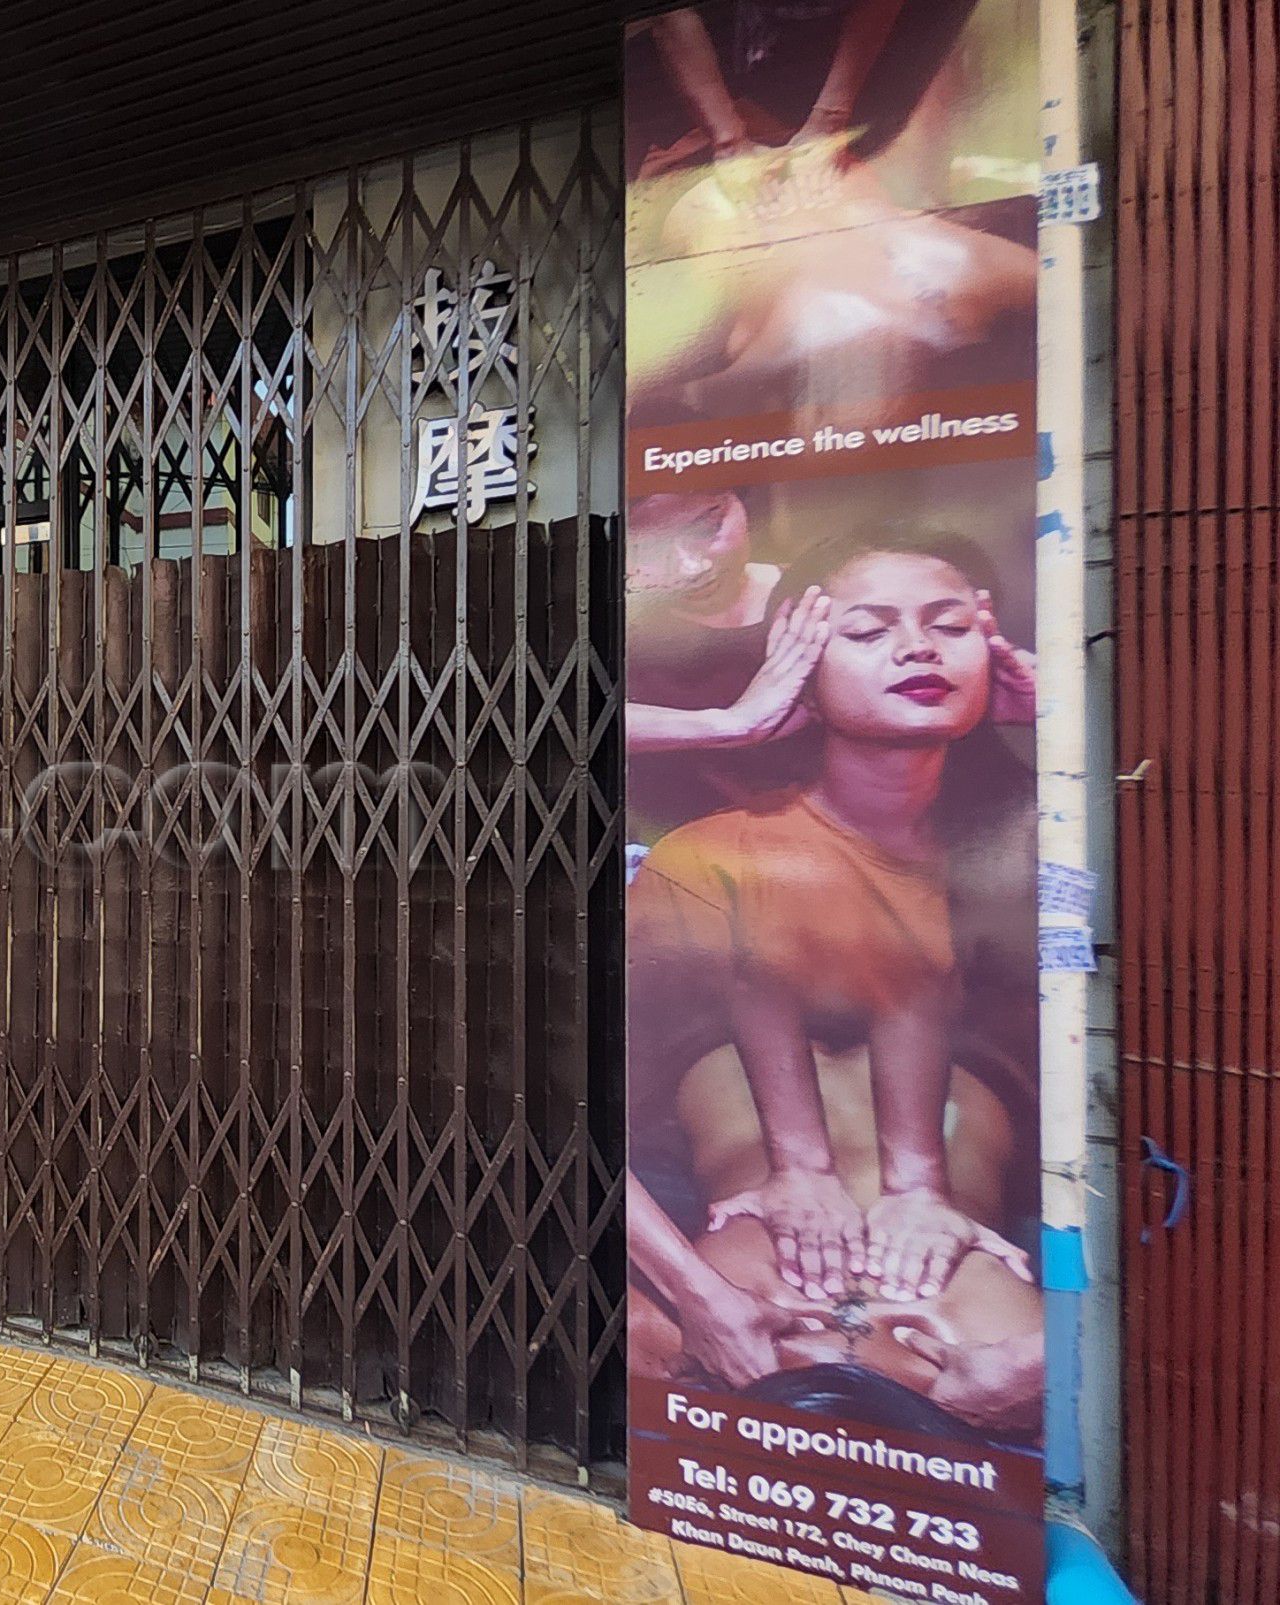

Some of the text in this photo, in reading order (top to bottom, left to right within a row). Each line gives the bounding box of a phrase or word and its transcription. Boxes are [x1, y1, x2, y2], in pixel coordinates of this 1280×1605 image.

[644, 412, 1019, 474] Experience the wellness
[667, 1392, 998, 1491] For appointment
[678, 1457, 981, 1551] Tel: 069 732 733
[719, 1503, 778, 1533] Street
[832, 1530, 885, 1562] Chey
[890, 1544, 954, 1575] Chom
[958, 1560, 1020, 1591] Neas
[671, 1518, 724, 1547] Khan
[850, 1562, 928, 1598] Phnom
